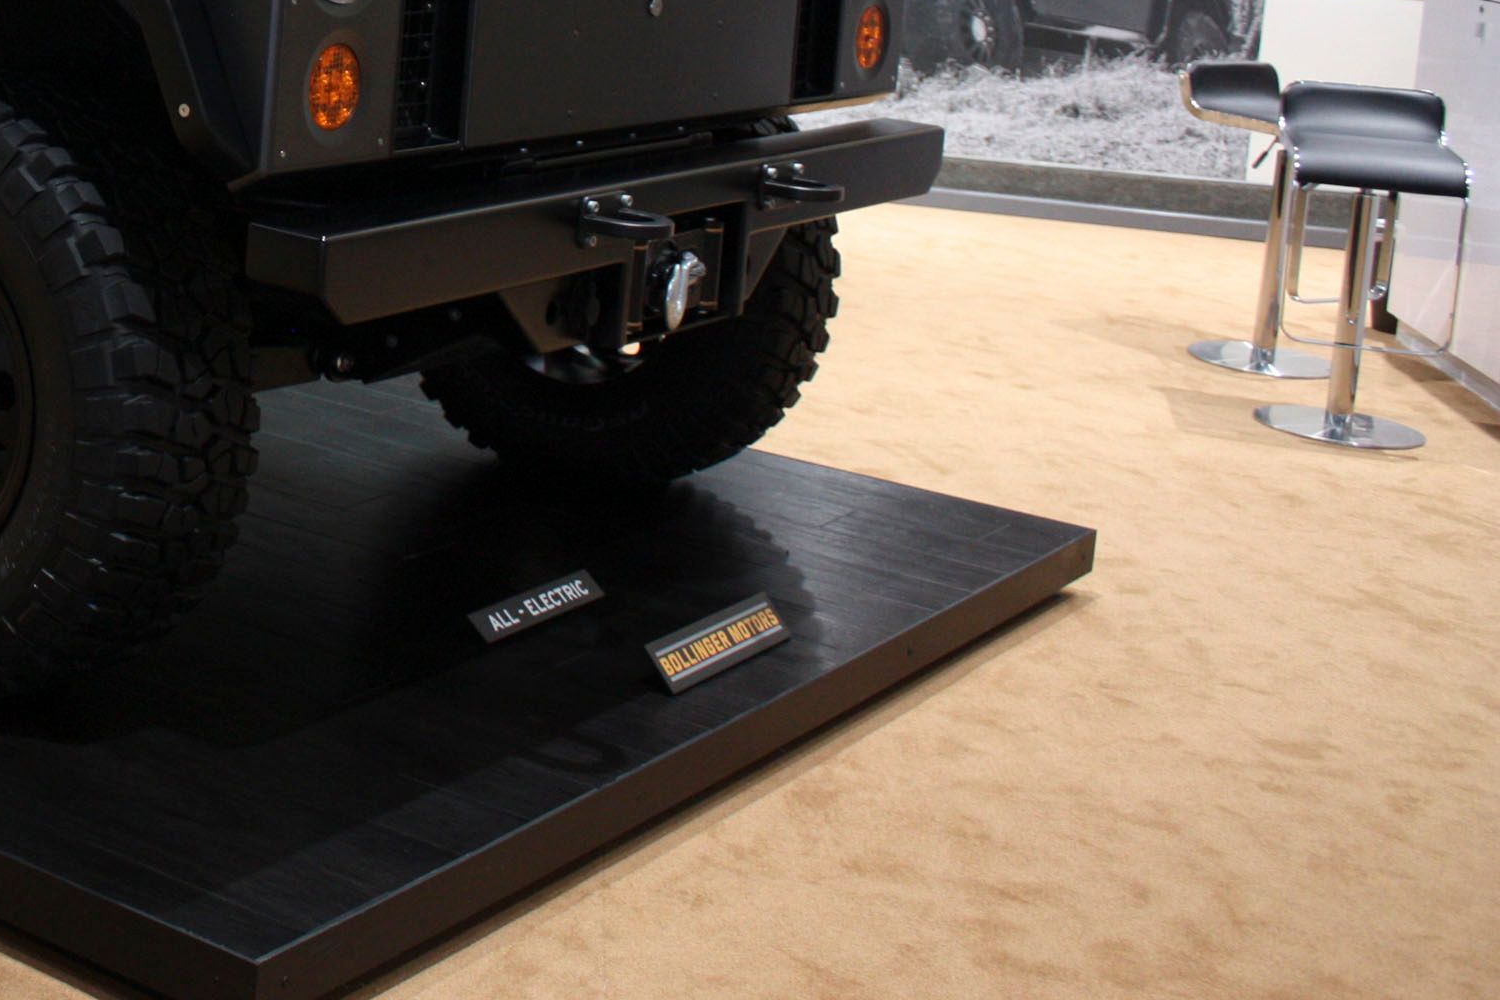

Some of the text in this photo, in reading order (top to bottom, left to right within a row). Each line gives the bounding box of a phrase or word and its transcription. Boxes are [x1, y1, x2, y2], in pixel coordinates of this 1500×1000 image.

[488, 608, 520, 632] ALL
[523, 580, 589, 616] ELECTRIC
[659, 608, 779, 677] BOLLINGER MOTORS
